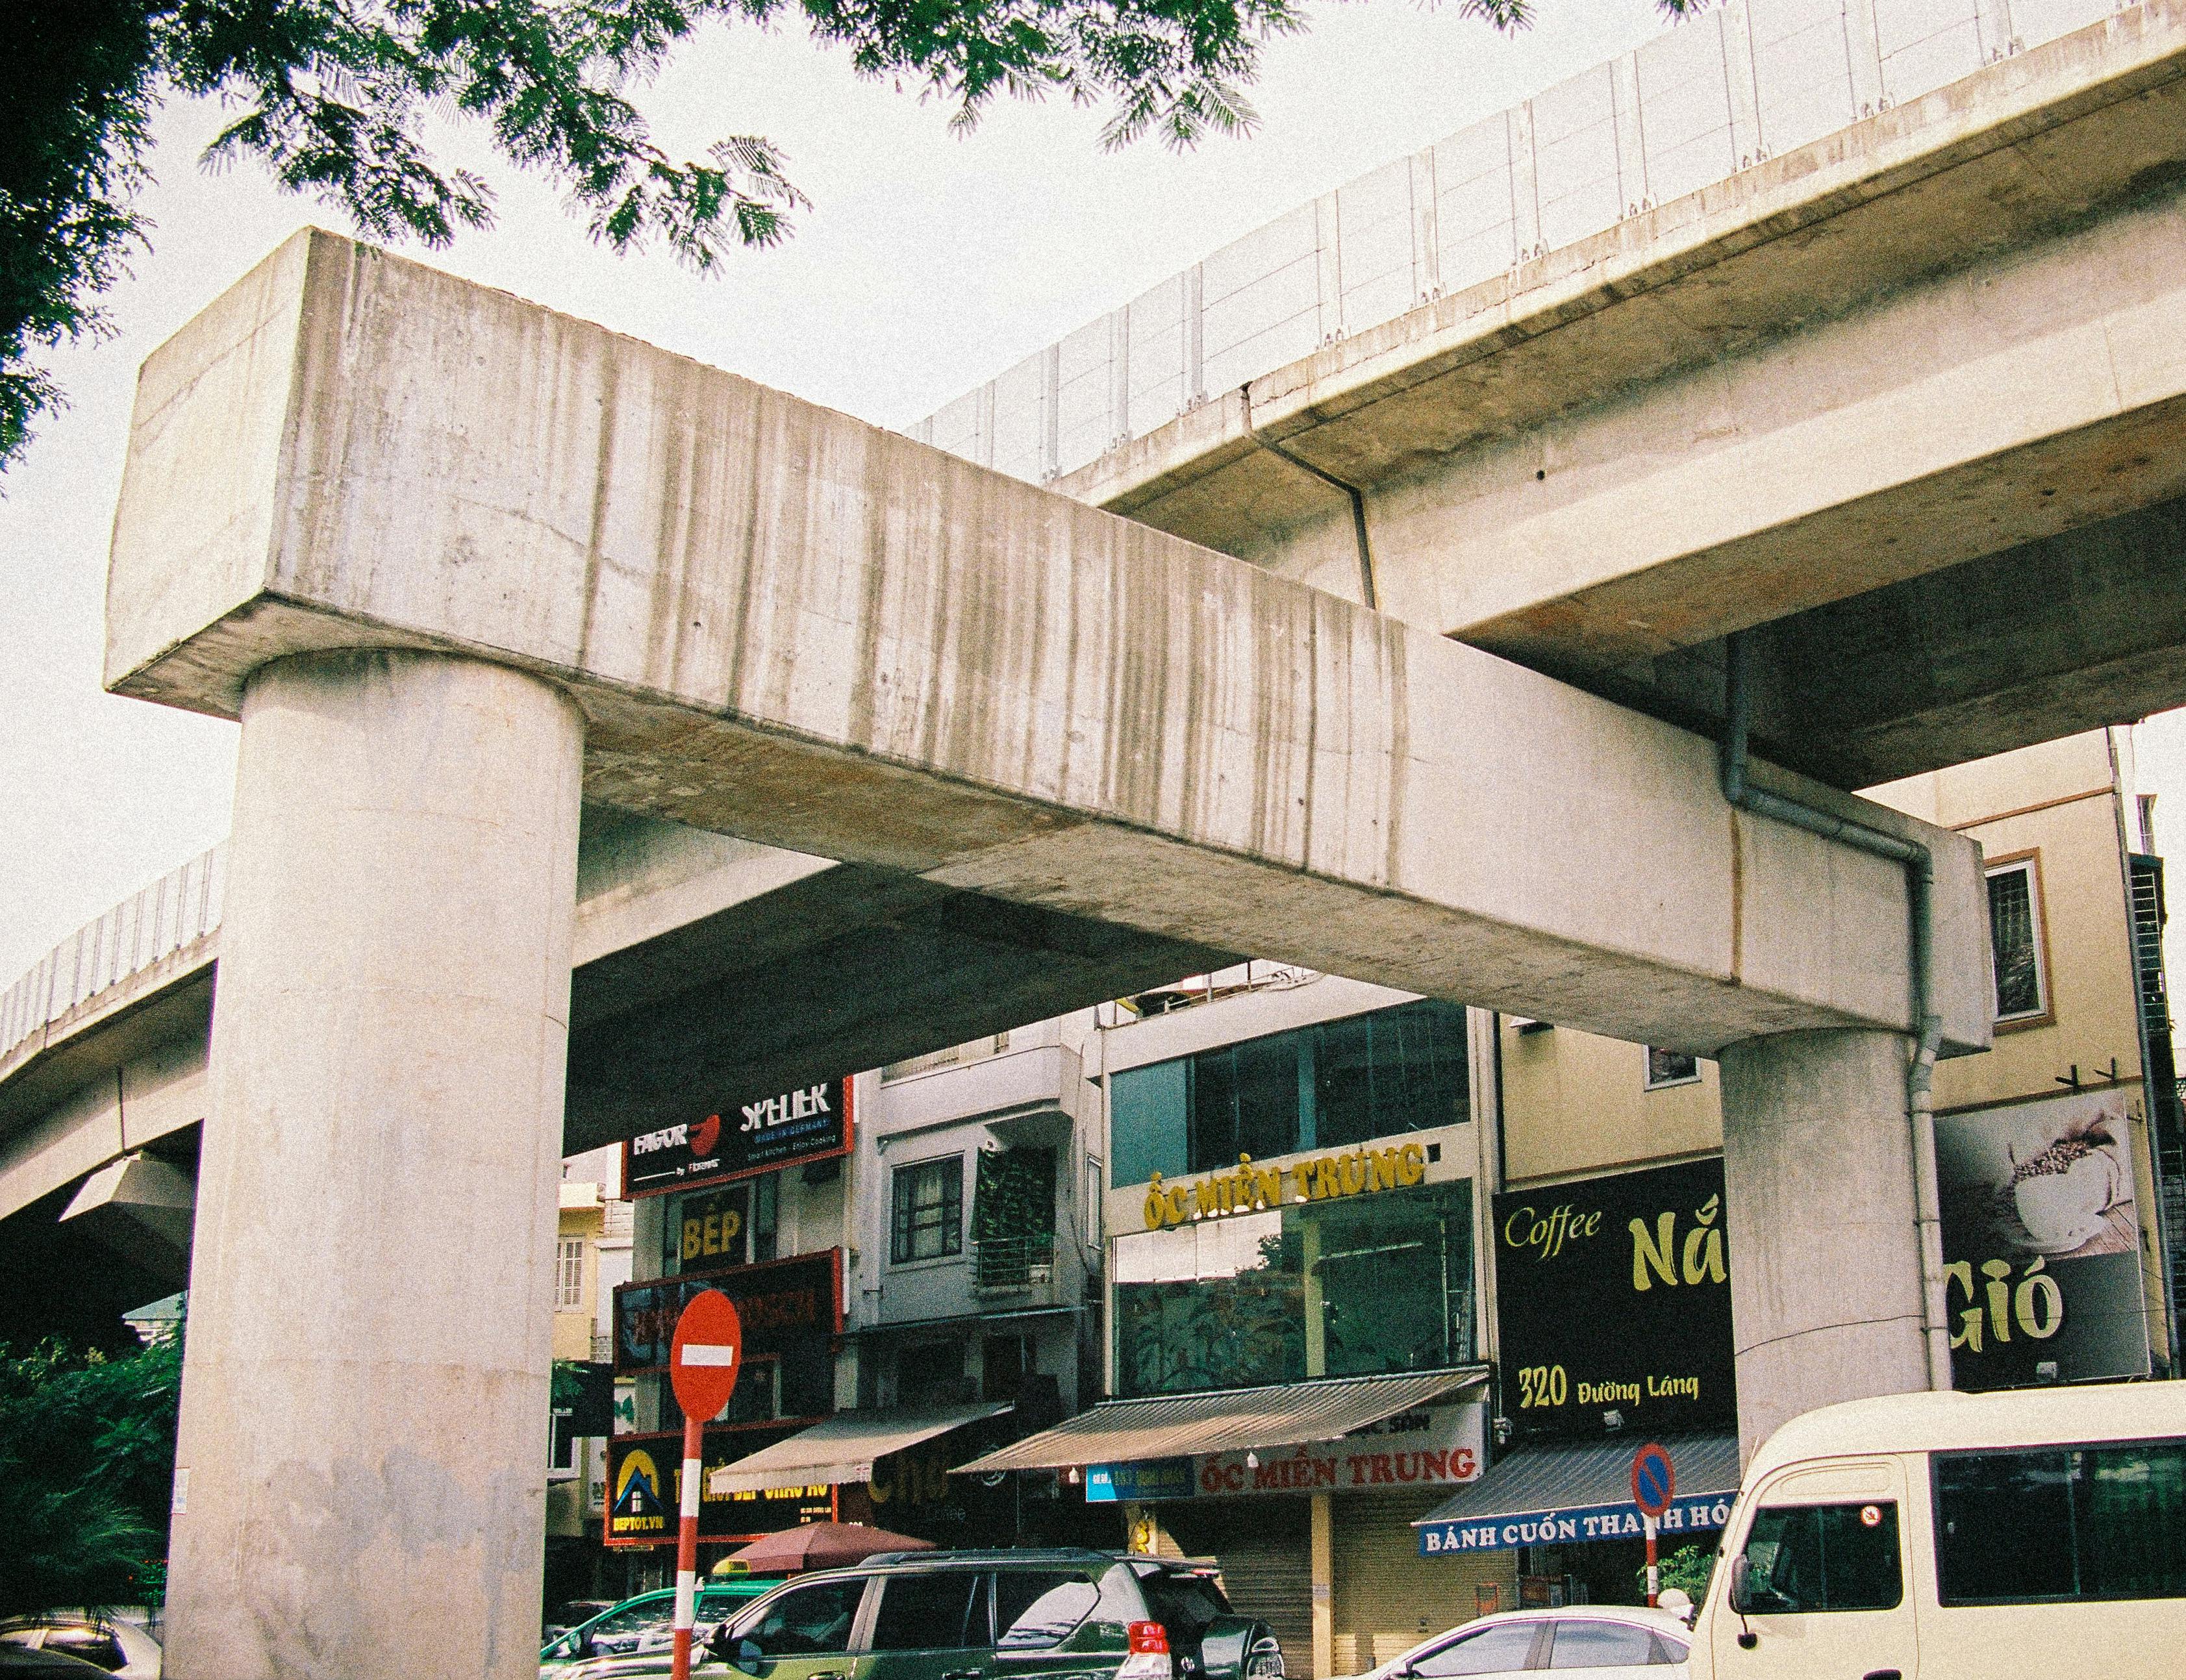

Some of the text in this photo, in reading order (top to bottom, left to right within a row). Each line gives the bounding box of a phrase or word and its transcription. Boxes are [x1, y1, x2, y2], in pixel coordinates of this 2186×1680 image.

[634, 1123, 688, 1155] FAGOR
[1292, 1142, 1426, 1203] TRUNG
[1505, 1203, 1602, 1262] Coffee
[1519, 1364, 1699, 1409] 320 Đường Láng
[1345, 1447, 1476, 1486] TRUNG
[613, 1516, 663, 1531] BEPTOT.VN
[1426, 1526, 1497, 1552] BÁNH
[1502, 1513, 1576, 1544] CUỐN
